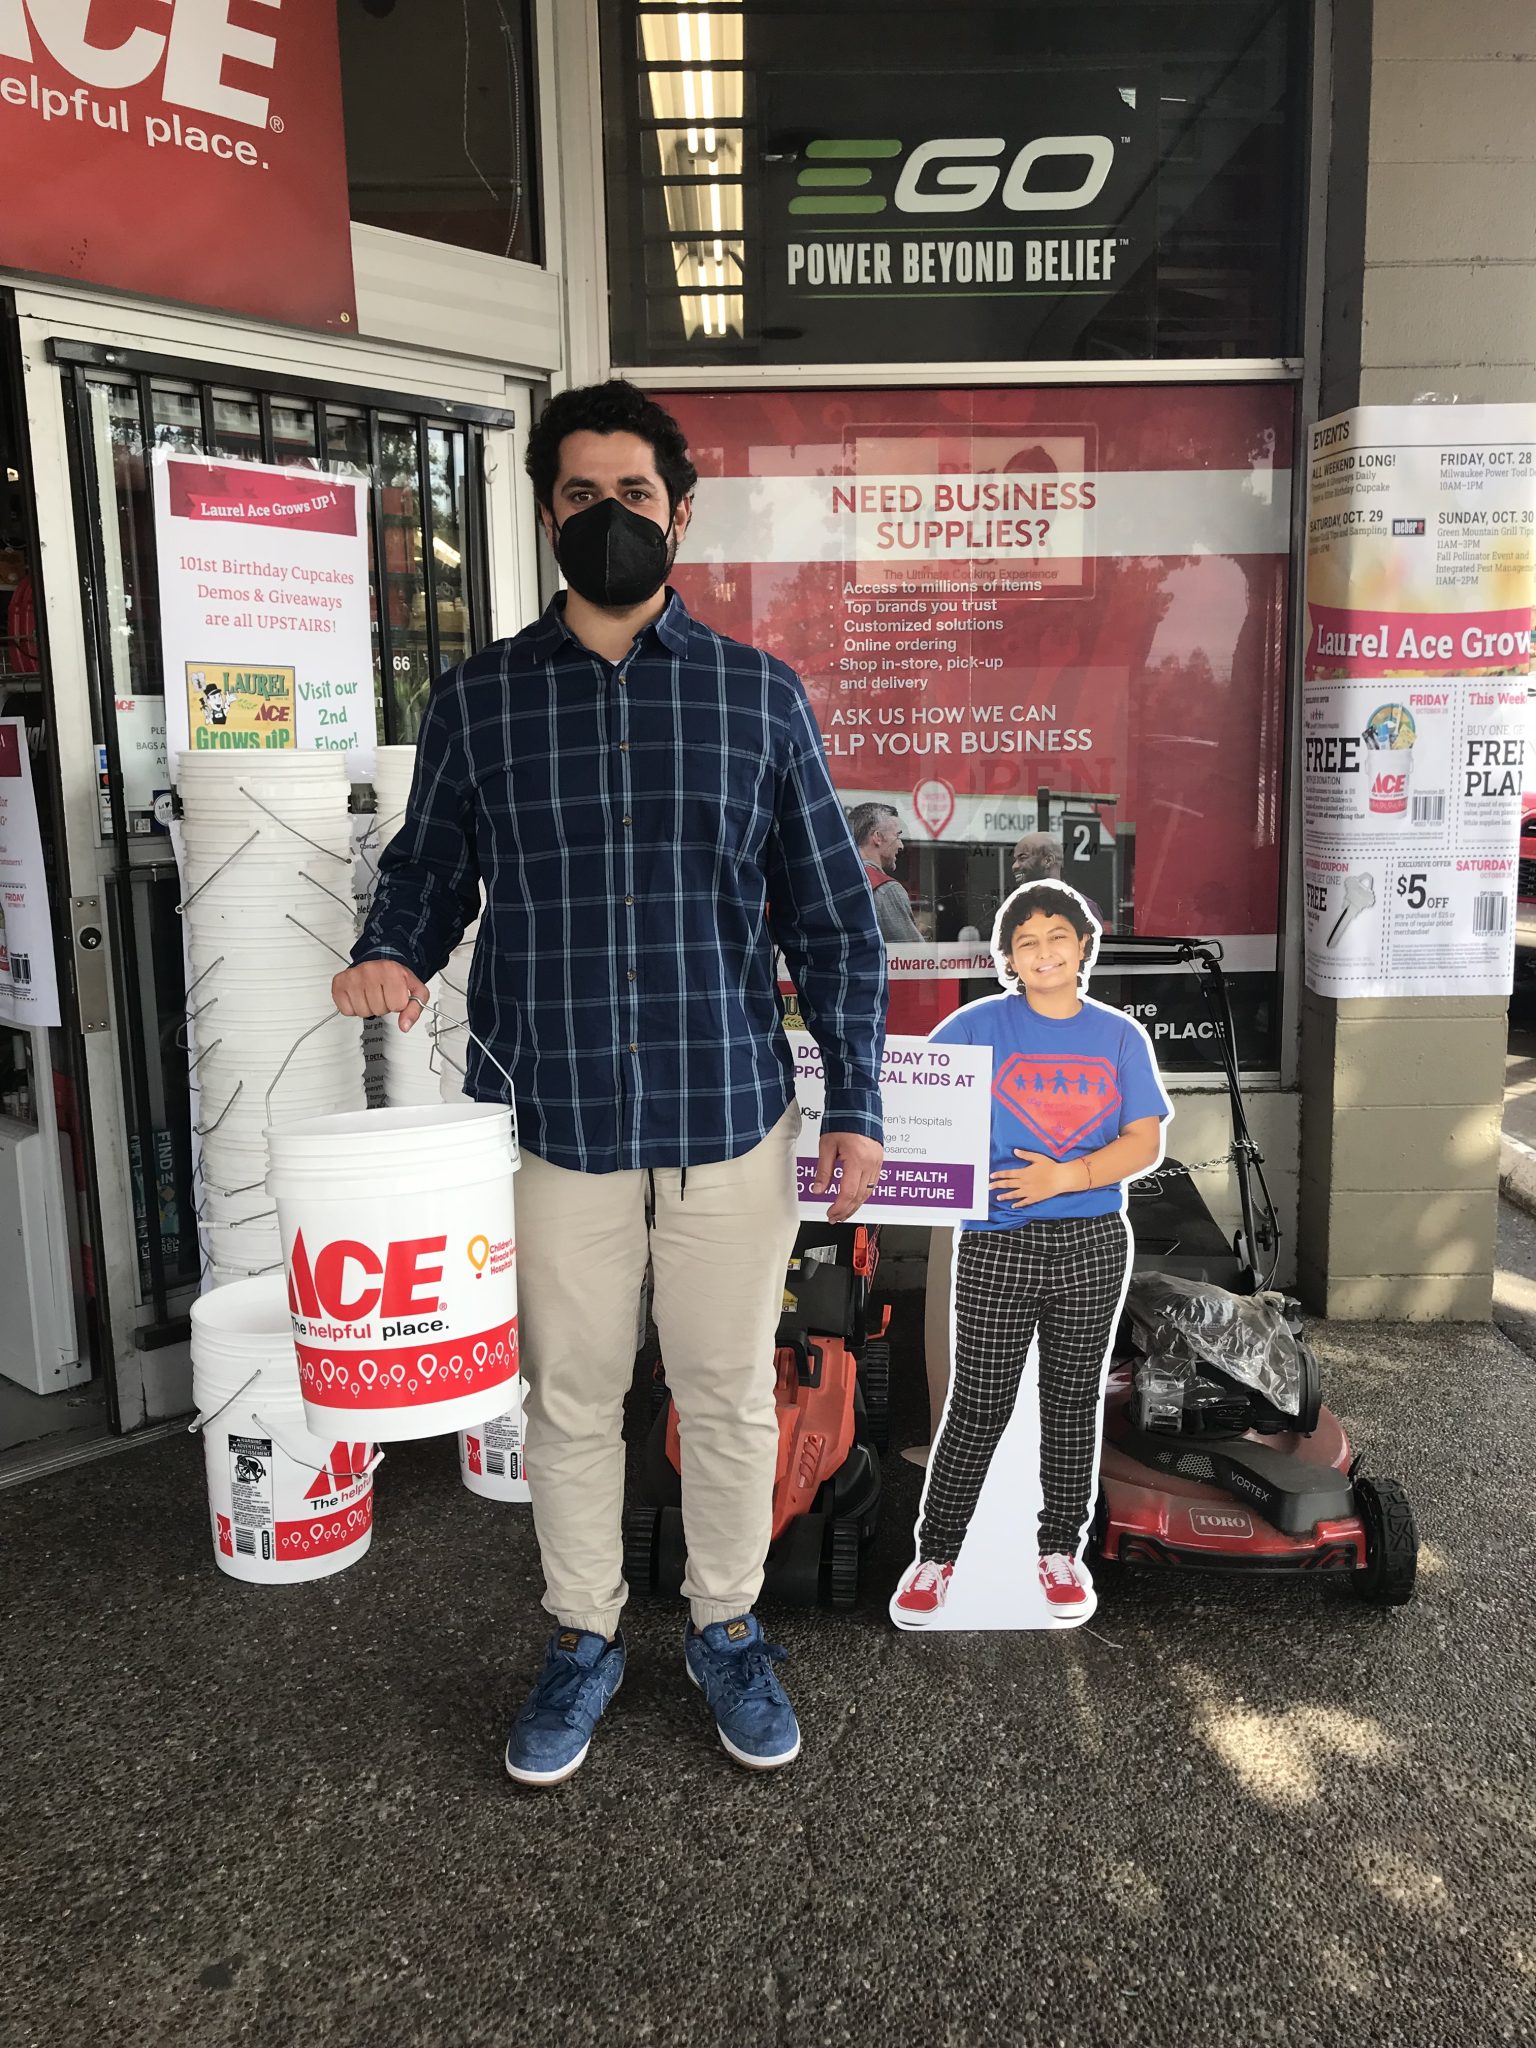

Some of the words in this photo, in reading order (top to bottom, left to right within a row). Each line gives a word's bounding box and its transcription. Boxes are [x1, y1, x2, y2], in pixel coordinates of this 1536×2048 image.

[0, 0, 281, 129] CE
[0, 75, 128, 133] elpful
[145, 114, 270, 170] place.
[788, 135, 1115, 215] EGO
[787, 242, 892, 285] POWER
[903, 240, 1014, 284] BEYOND
[1025, 238, 1117, 282] BELIEF
[1313, 421, 1350, 450] EVENTS
[1312, 466, 1323, 480] ALL
[1324, 456, 1356, 475] WEEKEND
[1358, 454, 1396, 468] LONG!
[1440, 452, 1485, 467] FRIDAY,
[1488, 452, 1516, 464] OCT.
[1518, 452, 1532, 464] 28
[1355, 470, 1377, 481] Daily
[1440, 468, 1484, 478] Milwaukee
[1485, 468, 1509, 477] Power
[1511, 467, 1527, 477] Tool
[1355, 483, 1391, 494] Cupcake
[832, 485, 923, 514] NEED
[934, 481, 1097, 513] BUSINESS
[200, 502, 245, 517] Laurel
[247, 503, 271, 517] Ace
[272, 501, 311, 516] Grows
[1310, 514, 1342, 532] SATURDAY,
[1342, 511, 1365, 524] OCT.
[1369, 510, 1384, 522] 29
[1438, 511, 1489, 526] SUNDAY,
[1492, 511, 1518, 523] OCT.
[1521, 511, 1534, 523] 30
[876, 519, 1051, 549] SUPPLIES?
[1349, 525, 1388, 537] Sampling
[1394, 520, 1418, 534] weber
[1437, 527, 1460, 537] Green
[1462, 526, 1499, 537] Mountain
[1500, 526, 1518, 536] Grill
[1437, 551, 1451, 561] Fall
[1453, 551, 1490, 561] Pollinator
[1492, 551, 1514, 560] Event
[1515, 551, 1530, 560] and
[179, 556, 218, 573] 101st
[221, 559, 289, 581] Birthday
[291, 566, 355, 585] Cupcakes
[884, 569, 904, 581] The
[1436, 563, 1475, 575] Integrated
[1477, 563, 1493, 573] Pest
[844, 581, 898, 594] Access
[901, 582, 917, 593] to
[920, 579, 979, 593] millions
[982, 579, 999, 592] of
[1001, 578, 1043, 592] items
[197, 584, 250, 602] Demos
[254, 588, 266, 602] &
[269, 590, 343, 610] Giveaways
[845, 600, 873, 616] Top
[875, 599, 927, 613] brands
[931, 602, 958, 618] you
[961, 598, 998, 612] trust
[205, 612, 230, 627] are
[233, 614, 253, 629] all
[256, 615, 338, 633] UPSTAIRS!
[843, 618, 932, 633] Customized
[936, 617, 1004, 632] solutions
[843, 638, 891, 652] Online
[895, 637, 957, 653] ordering
[1317, 624, 1389, 659] Laurel
[1395, 627, 1453, 660] Ace
[1461, 626, 1532, 659] Grow
[839, 658, 877, 672] Shop
[881, 657, 943, 672] in-store,
[946, 656, 1004, 672] pick-up
[223, 672, 290, 700] LAUREL
[297, 681, 333, 701] Visit
[335, 680, 359, 697] our
[839, 676, 868, 690] and
[871, 675, 929, 691] delivery
[1409, 694, 1450, 706] FRIDAY
[1468, 692, 1494, 705] This
[1496, 691, 1527, 705] Week
[254, 703, 290, 722] ACE
[318, 705, 348, 726] 2nd
[830, 708, 872, 726] ASK
[878, 707, 905, 725] US
[911, 706, 965, 724] HOW
[971, 705, 1004, 723] WE
[1009, 704, 1057, 722] CAN
[1467, 725, 1487, 736] BUY
[136, 742, 159, 750] BAGS
[314, 732, 360, 750] Floor!
[821, 734, 865, 756] ELP
[872, 732, 953, 755] YOUR
[960, 728, 1093, 754] BUSINESS
[1305, 737, 1361, 773] FREE
[1371, 771, 1407, 794] ACE
[1464, 771, 1523, 797] PLA
[984, 812, 1036, 831] PICKUP
[1073, 825, 1091, 861] 2
[1320, 861, 1349, 873] COUPON
[1456, 859, 1513, 871] SATURDAY
[1306, 883, 1327, 911] FREE
[1396, 873, 1427, 909] $5
[1426, 897, 1450, 908] OFF
[882, 1051, 925, 1065] ODAY
[928, 1053, 950, 1067] TO
[878, 1071, 907, 1084] CAL
[912, 1072, 951, 1087] KIDS
[955, 1075, 976, 1088] AT
[908, 1115, 953, 1127] Hospitals
[900, 1133, 911, 1142] 12
[157, 1131, 173, 1171] FIND
[884, 1146, 927, 1155] osarcoma
[895, 1170, 948, 1184] HEALTH
[900, 1186, 955, 1200] FUTURE
[490, 1250, 509, 1265] Miracle
[288, 1225, 448, 1322] ACE
[291, 1315, 307, 1335] The
[308, 1323, 372, 1343] helpful
[382, 1318, 450, 1341] place.
[1230, 1471, 1271, 1502] VORTEX
[310, 1496, 339, 1511] The
[1195, 1513, 1246, 1528] TORO
